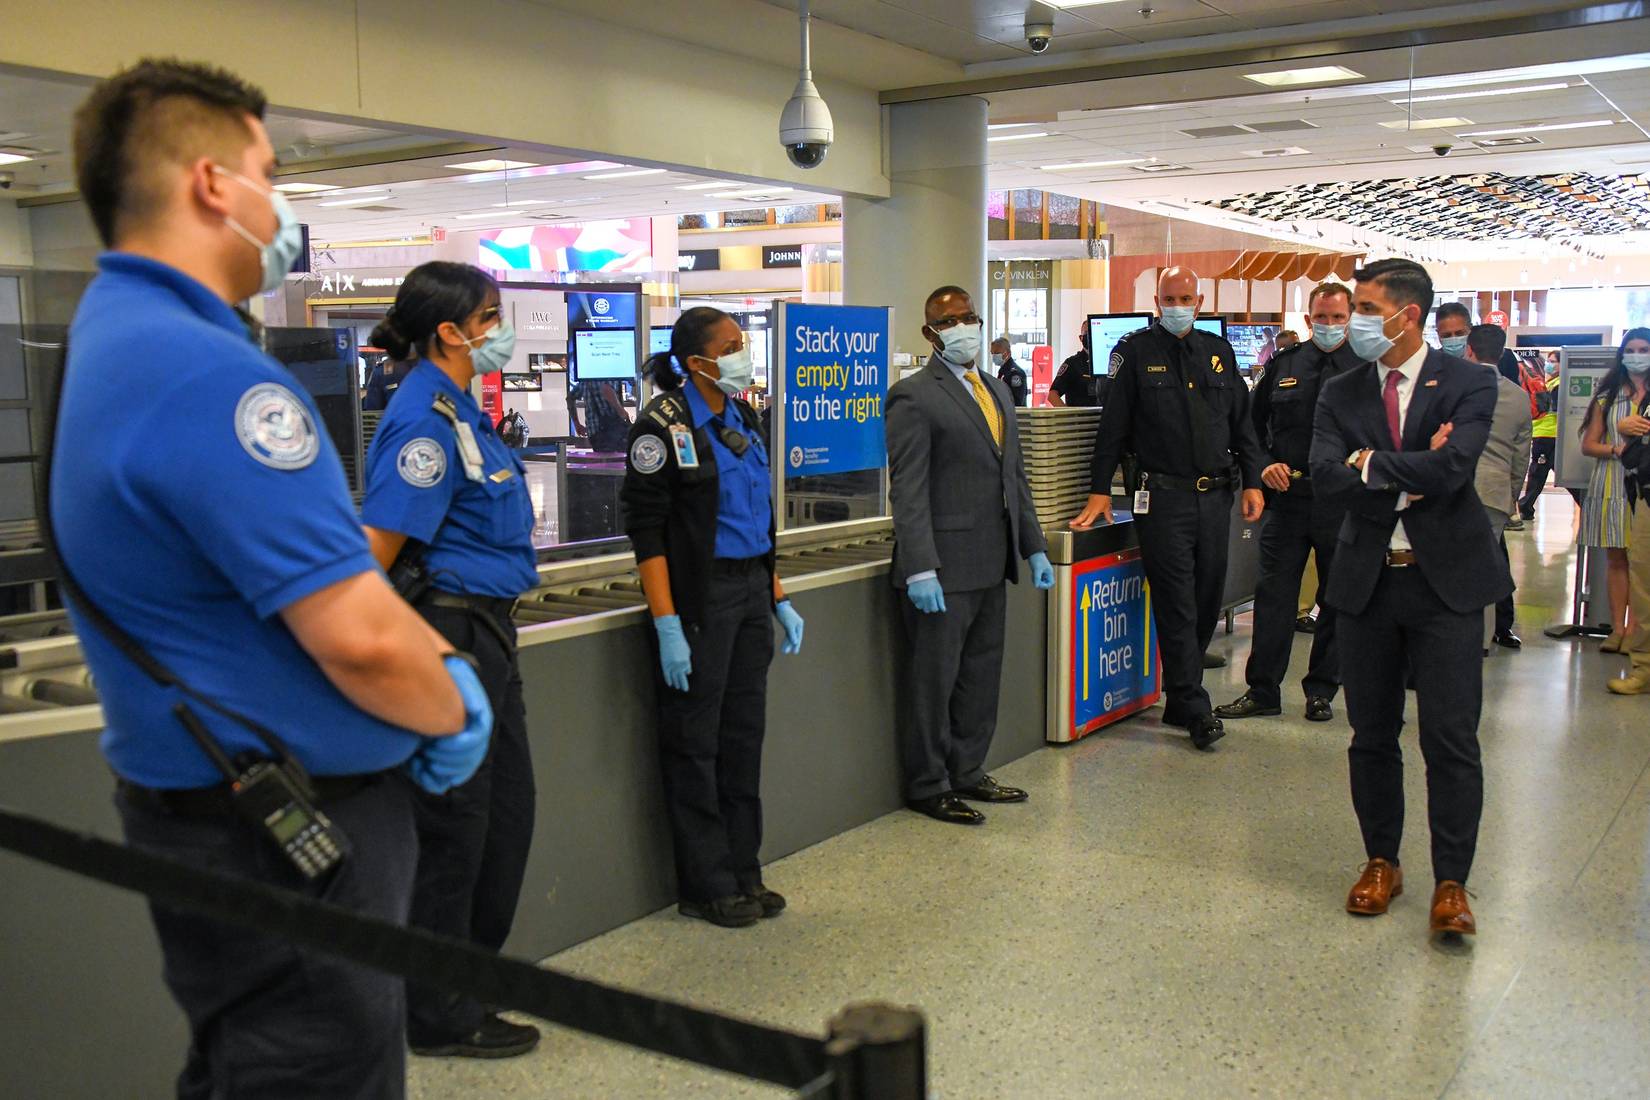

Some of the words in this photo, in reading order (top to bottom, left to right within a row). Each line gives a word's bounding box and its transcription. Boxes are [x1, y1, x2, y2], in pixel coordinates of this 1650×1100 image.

[769, 251, 801, 264] JOHNN
[1026, 270, 1049, 280] KLEIN
[530, 311, 553, 322] IWC
[338, 334, 348, 350] 5
[795, 325, 840, 353] Stack
[843, 331, 880, 358] your
[796, 361, 850, 391] empty
[854, 359, 878, 386] bin
[792, 395, 810, 422] to
[814, 393, 841, 421] the
[844, 391, 881, 423] right
[1091, 576, 1141, 612] Return
[1104, 609, 1127, 643] bin
[1099, 644, 1132, 679] here
